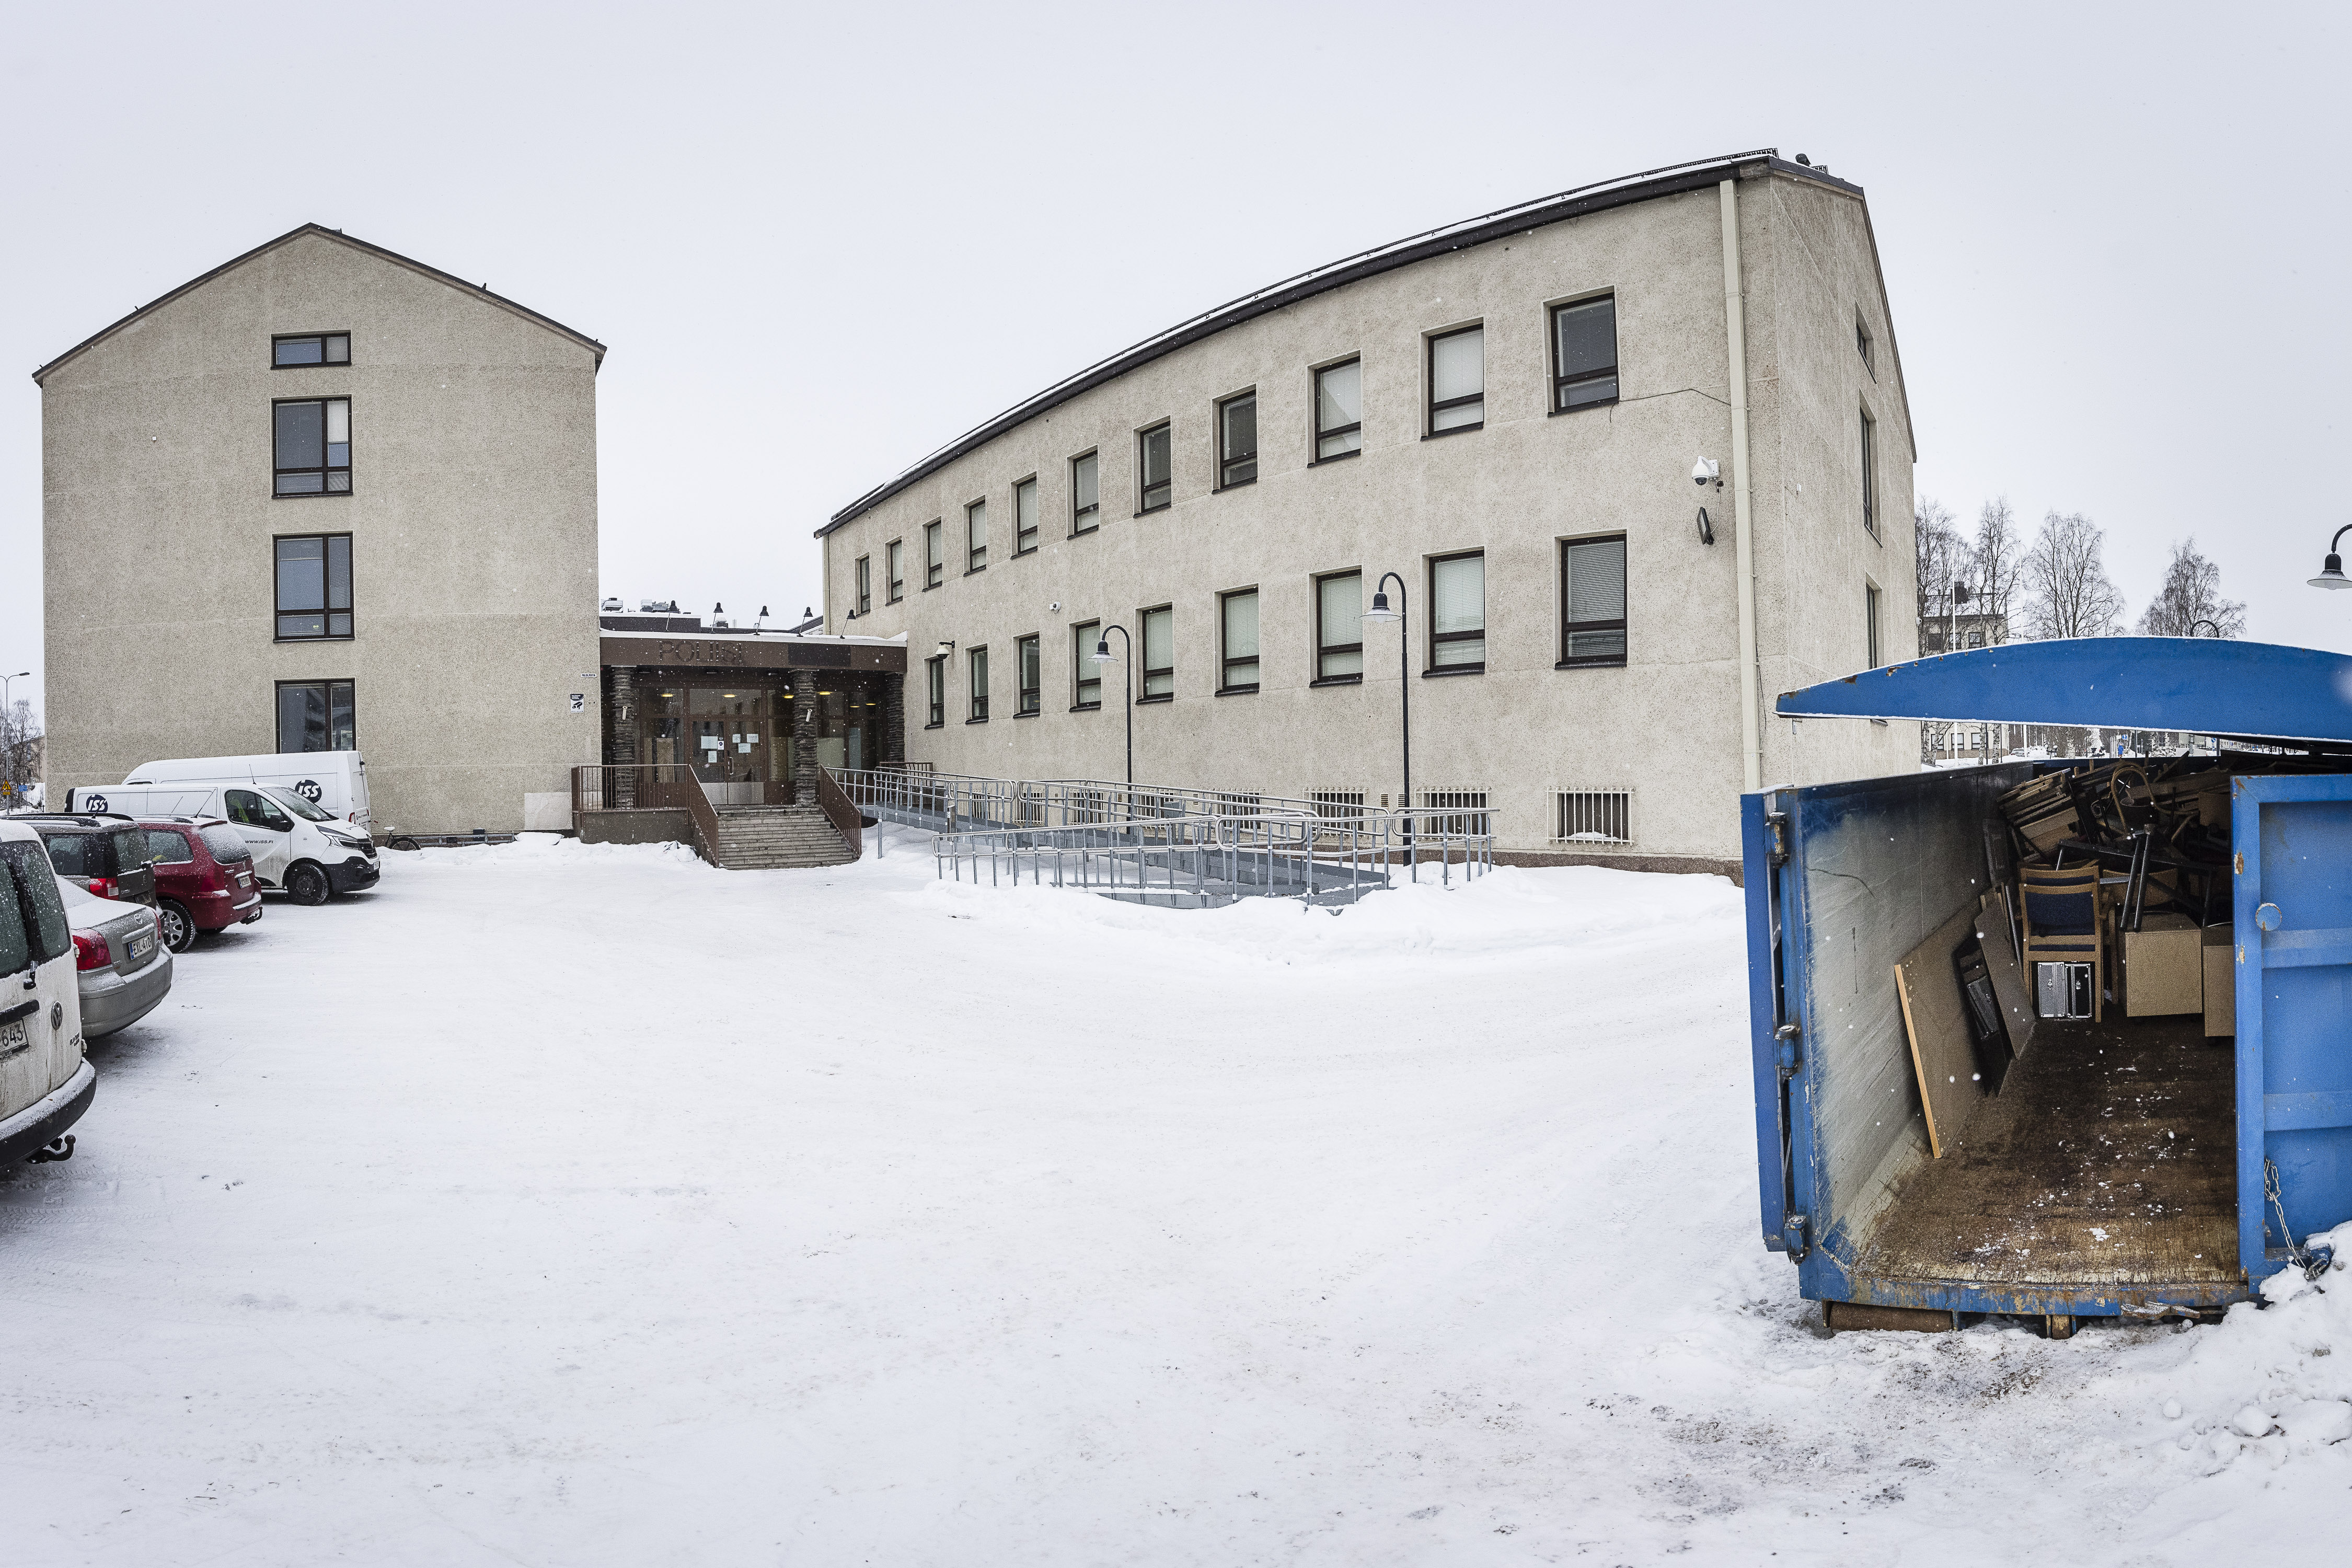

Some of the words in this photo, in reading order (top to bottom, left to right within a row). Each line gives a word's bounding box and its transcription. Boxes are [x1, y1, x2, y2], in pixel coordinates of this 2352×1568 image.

[659, 641, 742, 662] POLIISI
[298, 780, 319, 798] ISS
[87, 795, 106, 811] ISS
